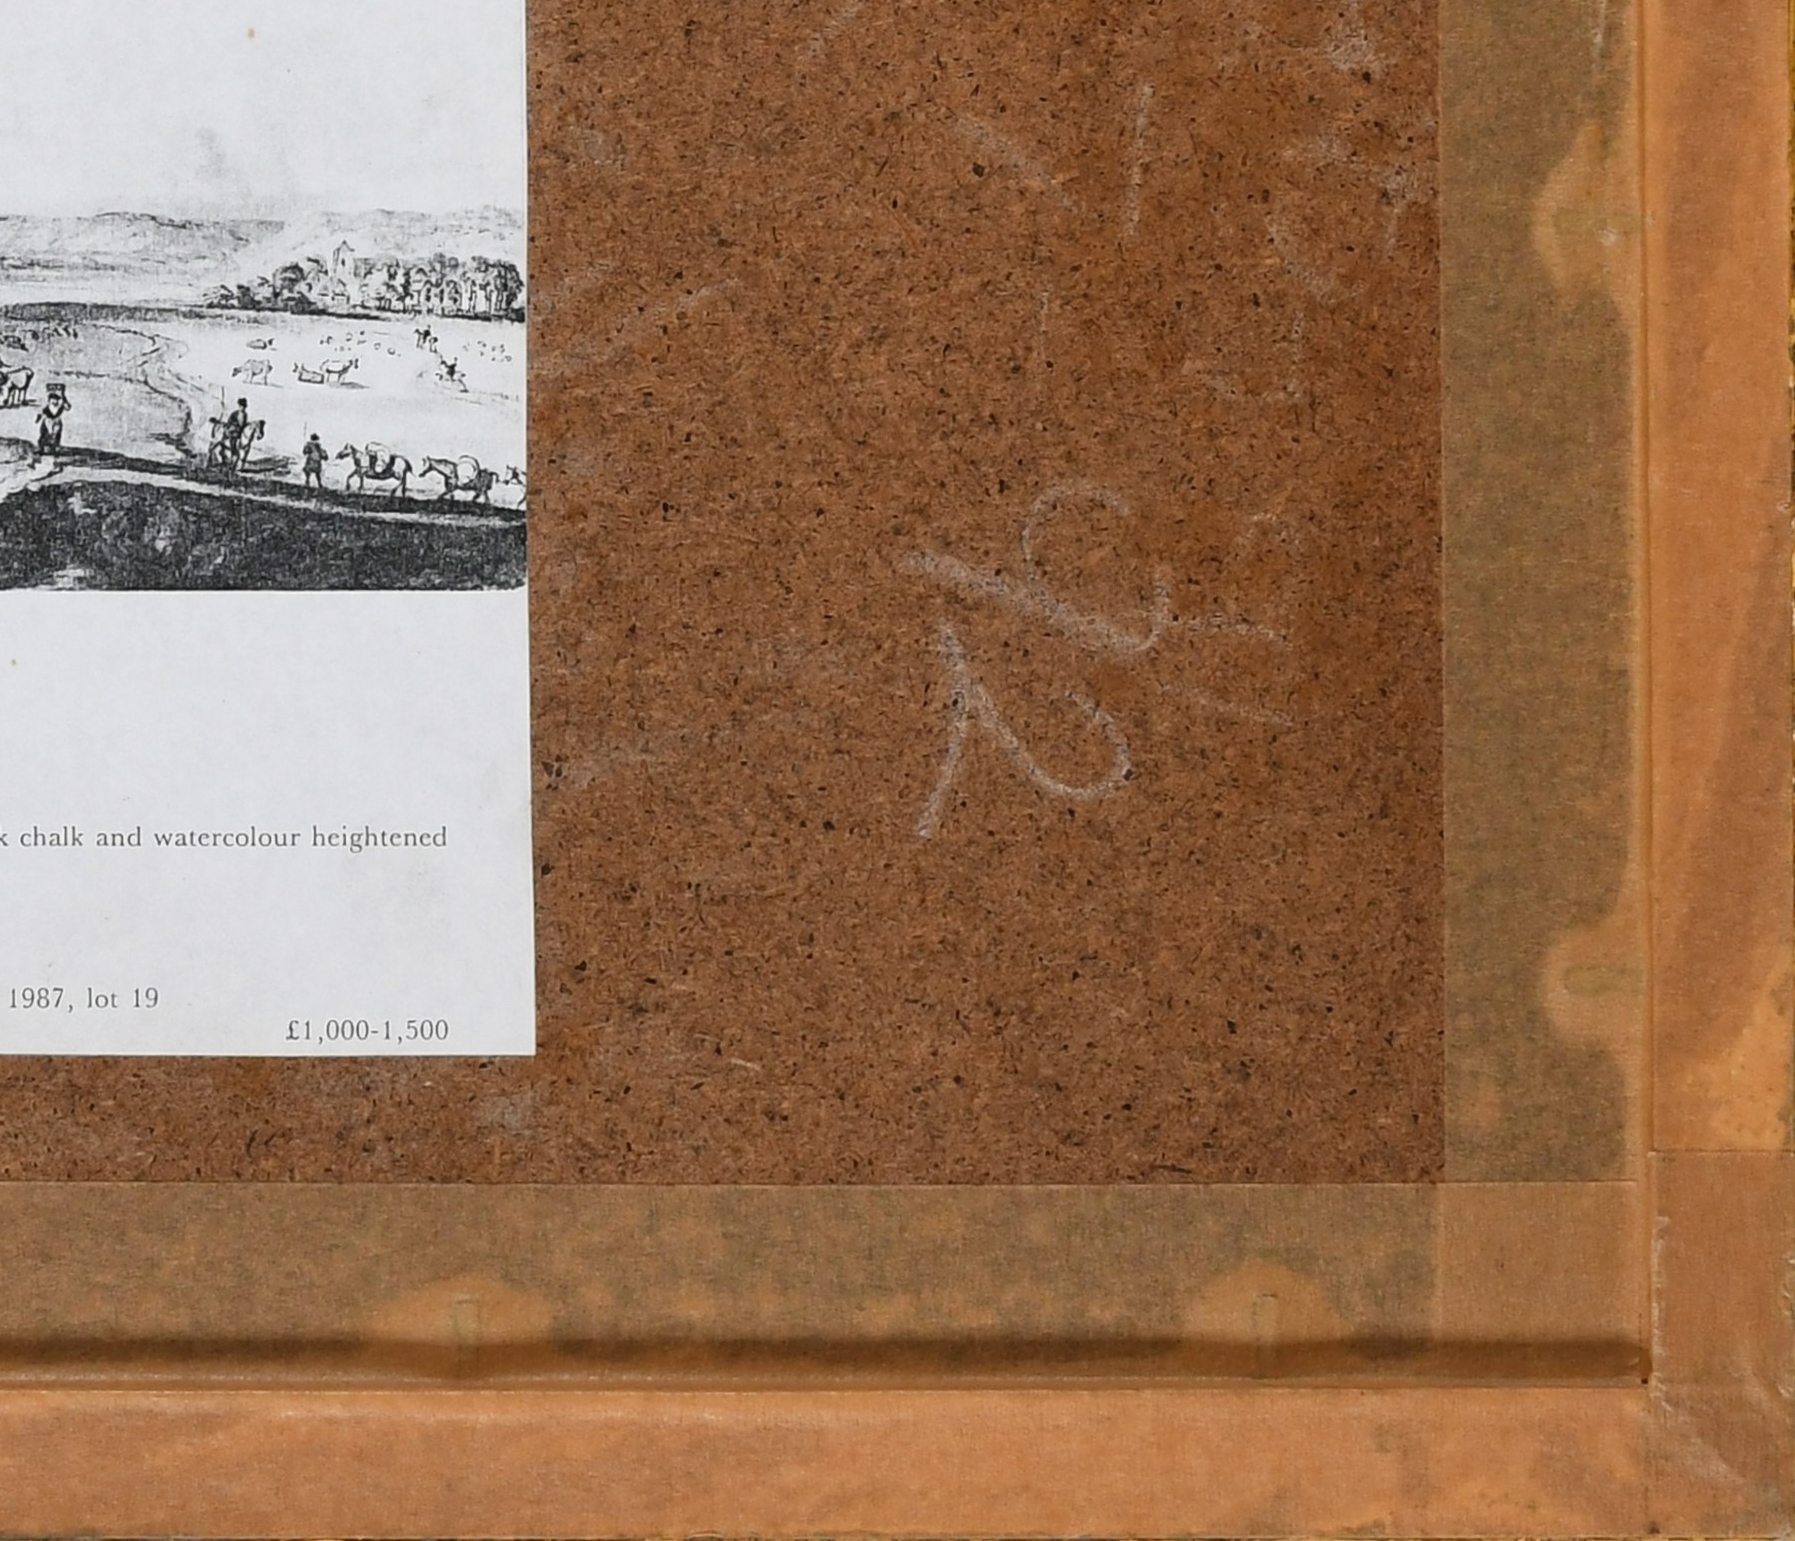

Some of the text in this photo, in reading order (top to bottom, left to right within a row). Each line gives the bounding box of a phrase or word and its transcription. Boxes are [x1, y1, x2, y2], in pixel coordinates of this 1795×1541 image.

[19, 825, 84, 847] chalk
[96, 825, 142, 847] and
[153, 825, 301, 847] watercolour
[312, 824, 447, 854] heightened
[10, 987, 74, 1014] 1987,
[87, 987, 118, 1009] lot
[133, 987, 159, 1009] 19
[285, 1019, 449, 1045] £1,000-1,500
